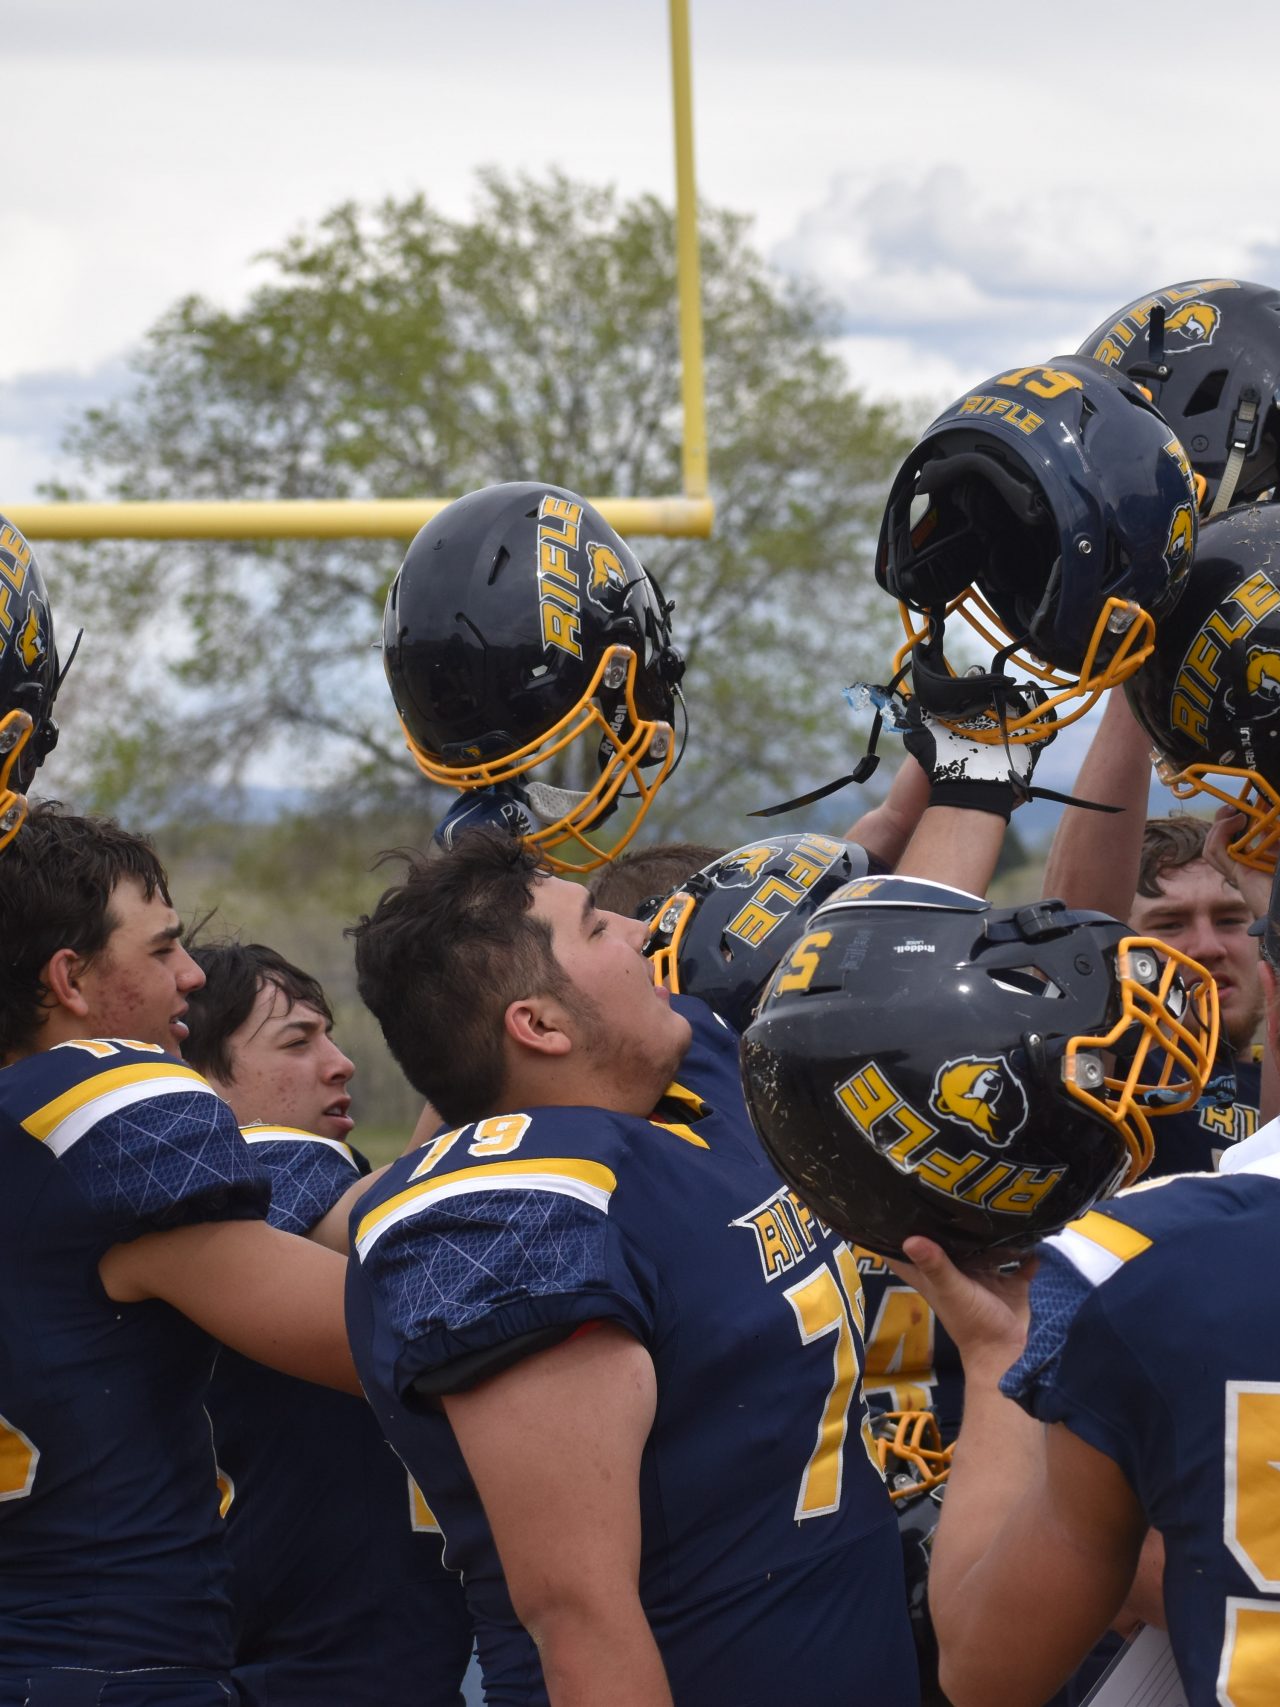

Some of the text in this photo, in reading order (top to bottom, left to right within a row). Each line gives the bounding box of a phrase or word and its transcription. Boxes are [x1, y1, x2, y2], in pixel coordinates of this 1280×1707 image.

[955, 395, 1045, 436] RIFLE
[537, 494, 584, 662] RIFLE
[725, 833, 847, 948] RIFLE
[406, 1112, 533, 1184] 79
[835, 1060, 1069, 1215] RIFLE
[729, 1185, 833, 1285] RIF
